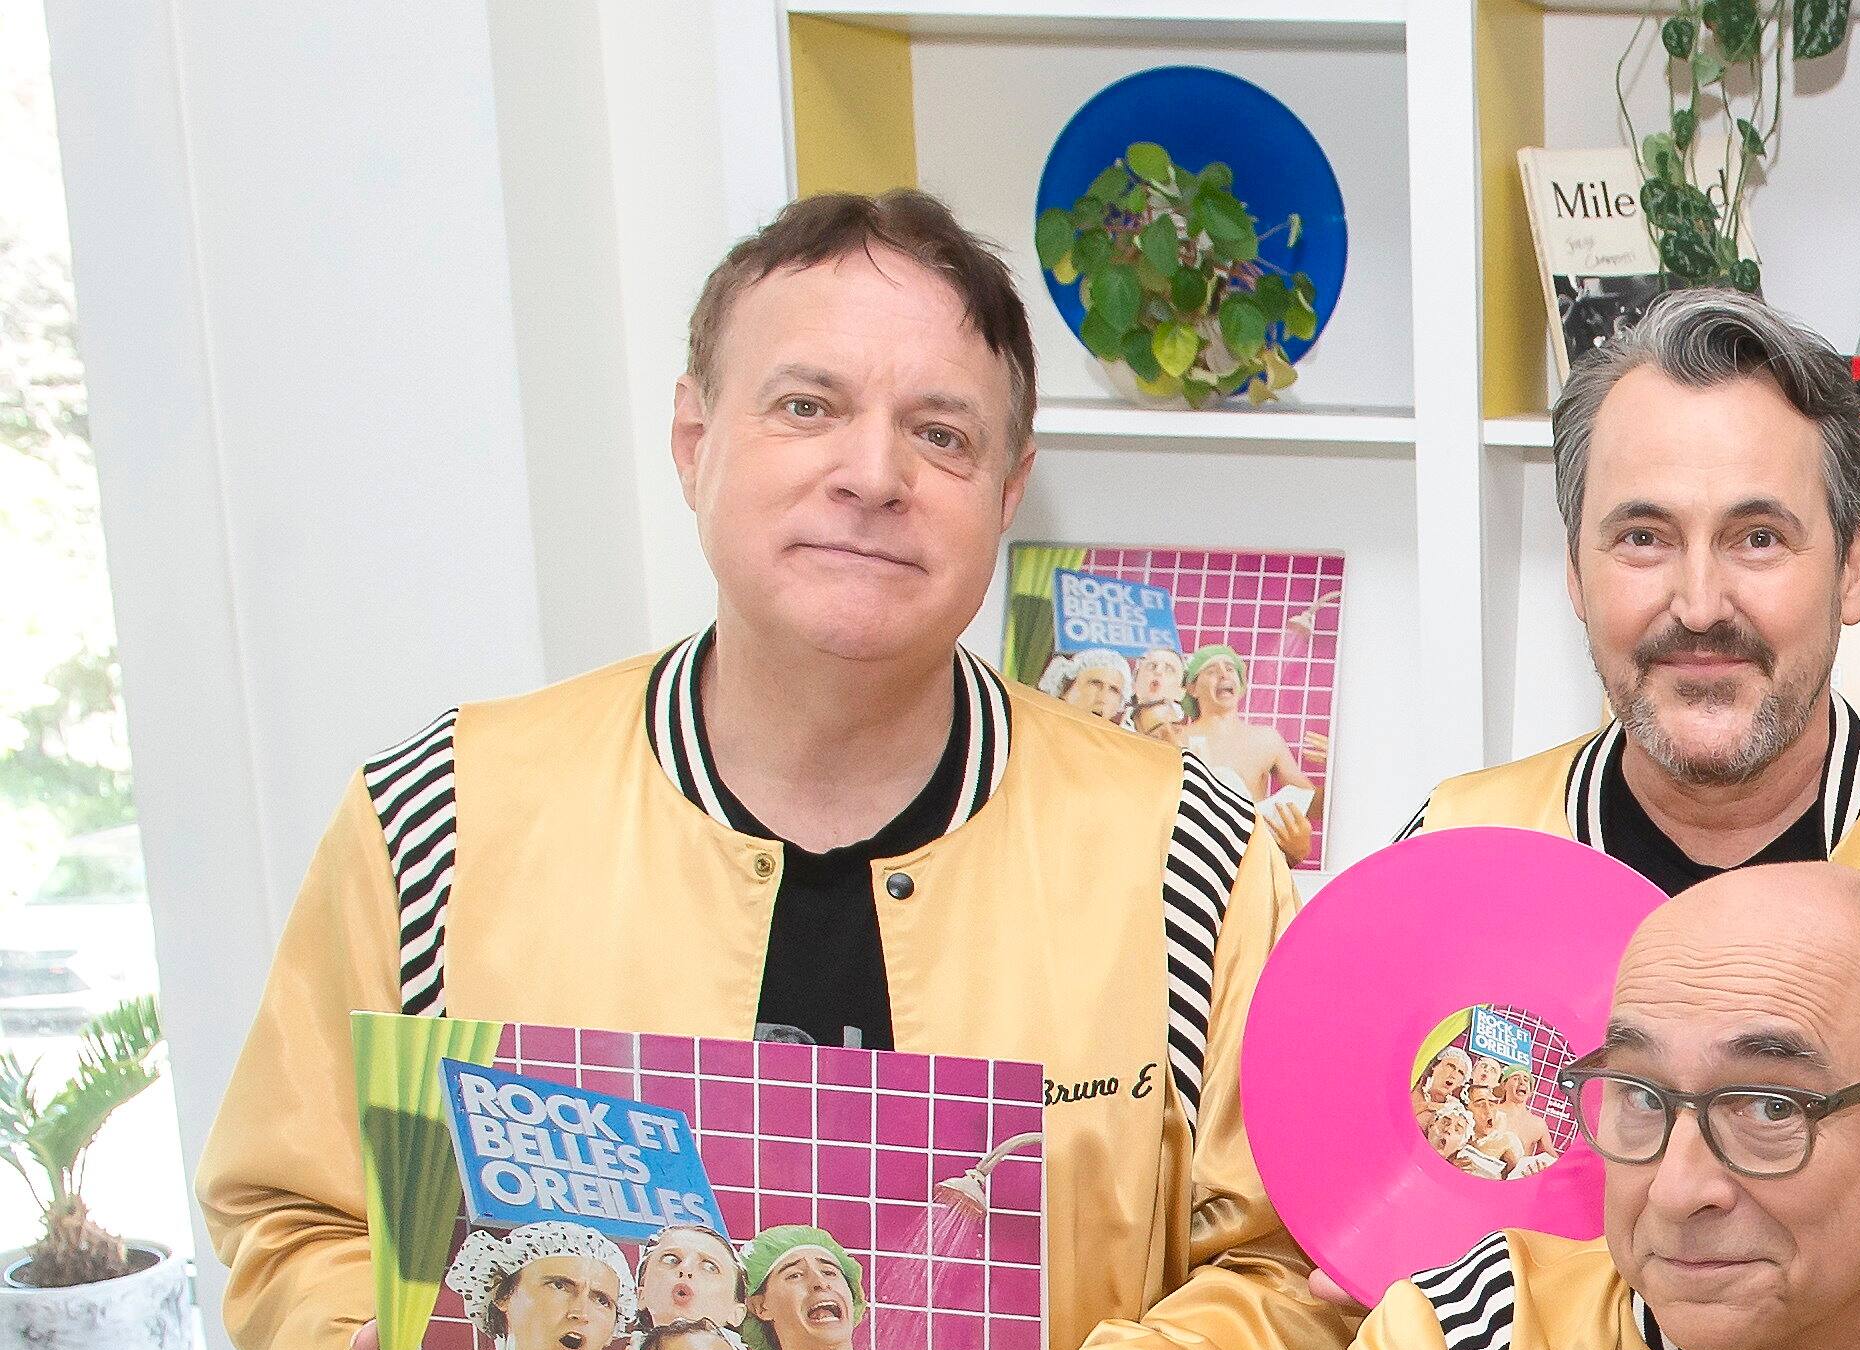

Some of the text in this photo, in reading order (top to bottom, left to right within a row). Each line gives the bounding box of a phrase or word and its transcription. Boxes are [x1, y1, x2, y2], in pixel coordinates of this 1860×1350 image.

[1551, 181, 1637, 219] Mile
[1062, 573, 1135, 603] ROCK
[1477, 1021, 1518, 1048] BELLES
[1478, 1010, 1529, 1042] ROCK ET
[1475, 1036, 1529, 1064] OREILLES
[460, 1073, 679, 1153] ROCK ET
[470, 1114, 650, 1185] BELLES
[481, 1161, 714, 1228] OREILLES
